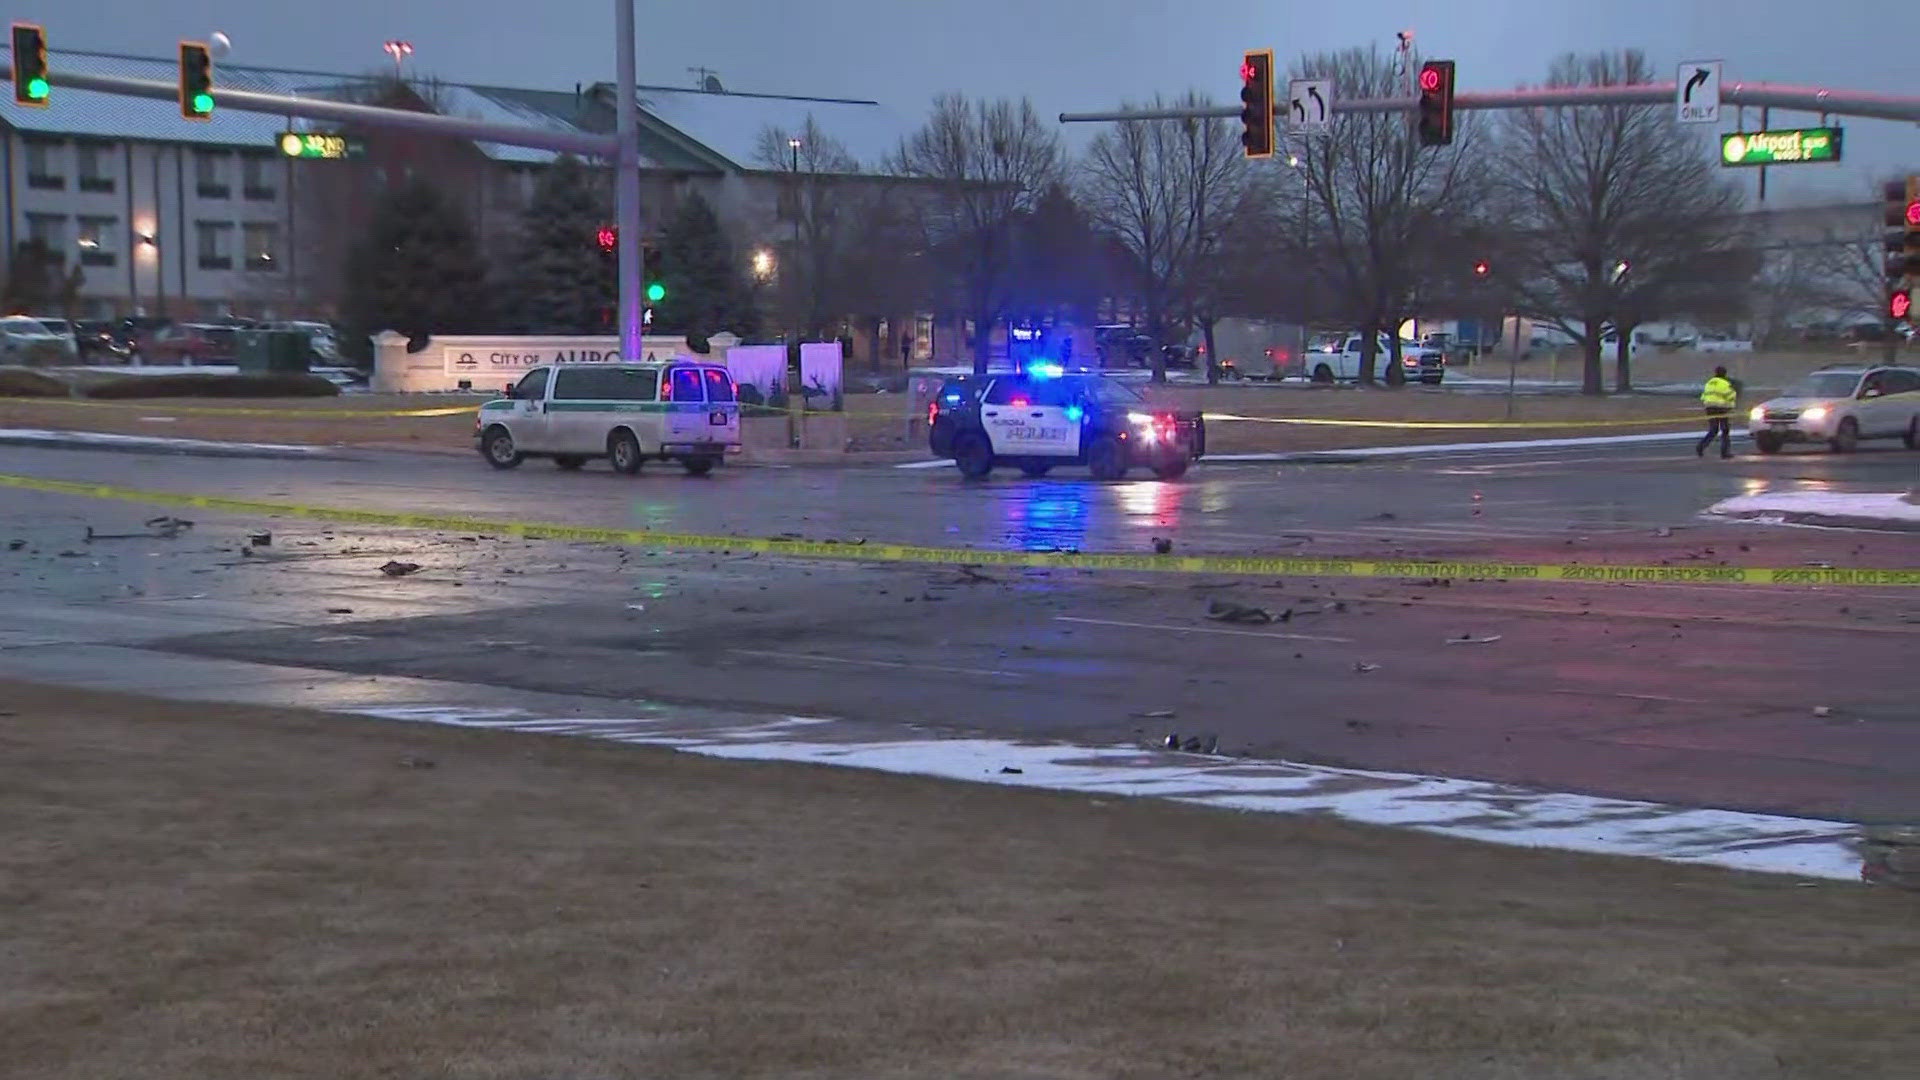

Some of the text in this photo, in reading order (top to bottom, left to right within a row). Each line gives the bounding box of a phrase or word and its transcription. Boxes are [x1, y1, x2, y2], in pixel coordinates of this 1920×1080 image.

[1681, 105, 1715, 119] ONLY
[1746, 131, 1802, 154] Airport
[490, 352, 520, 364] CITY
[523, 354, 540, 364] OF
